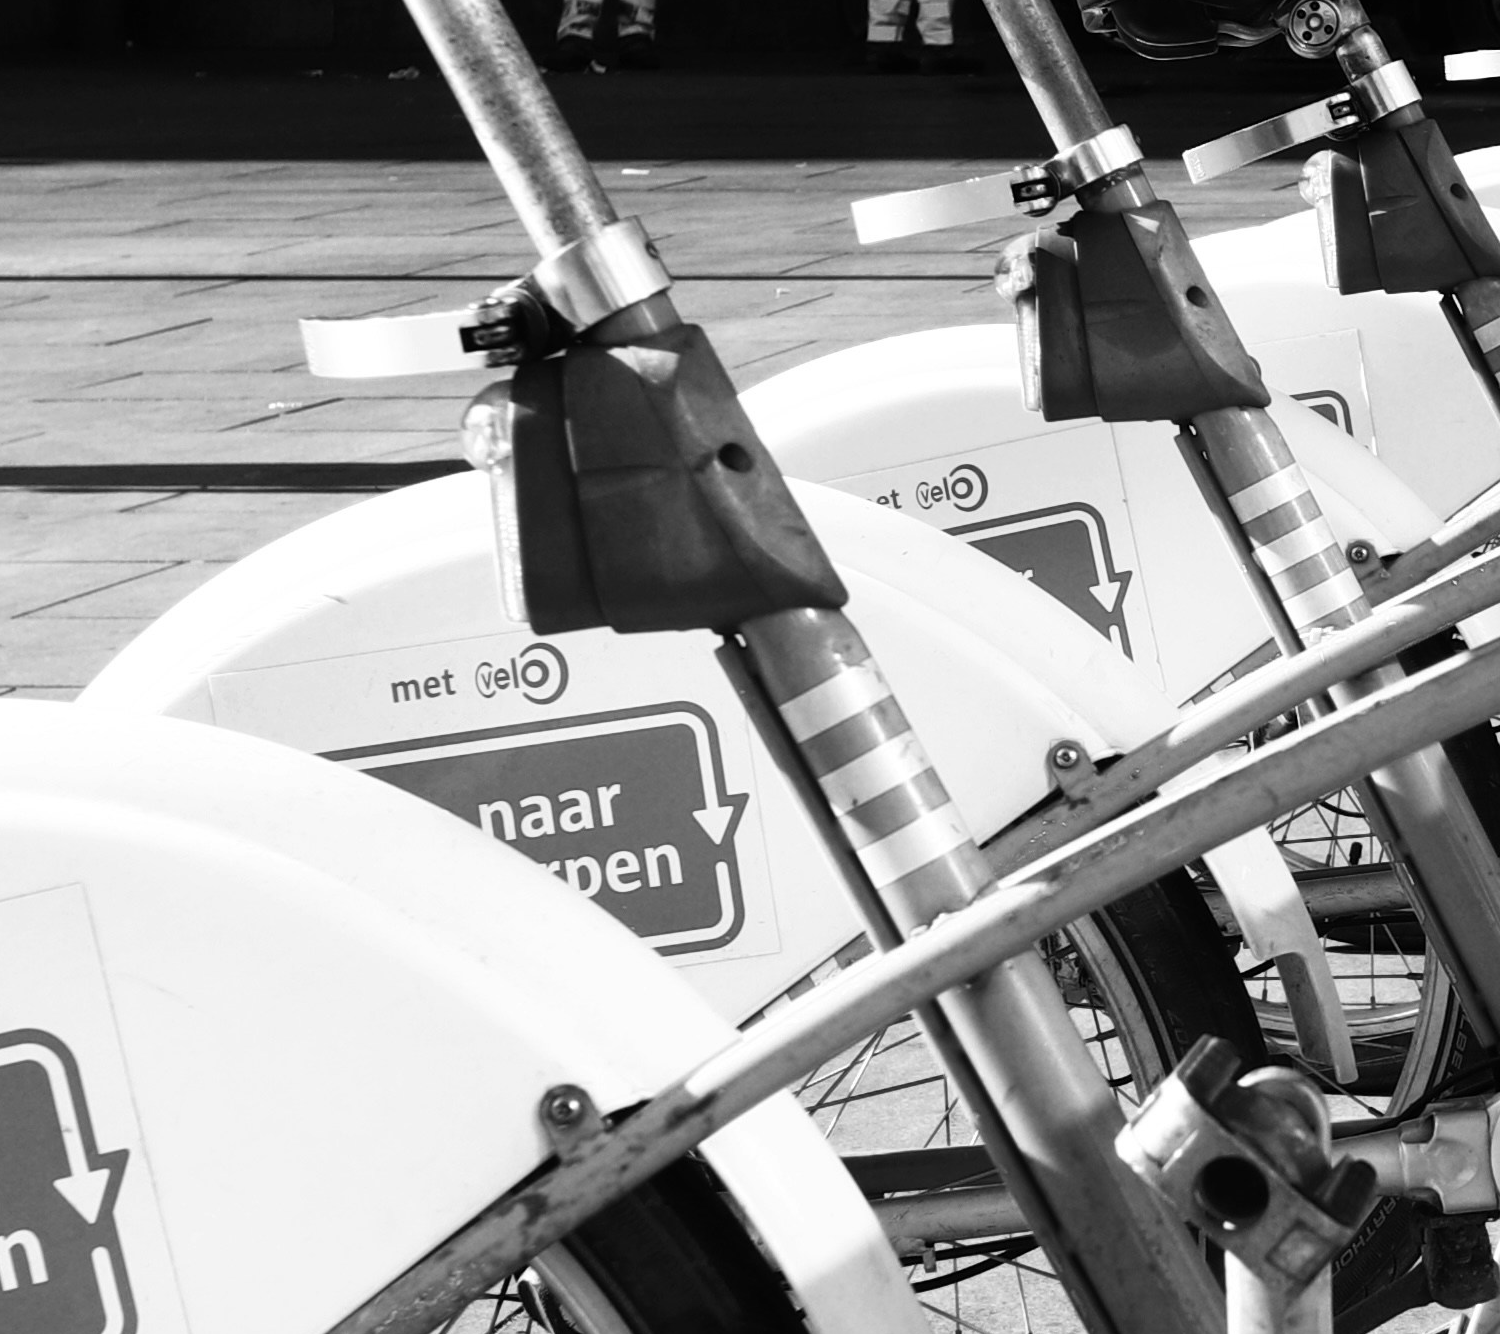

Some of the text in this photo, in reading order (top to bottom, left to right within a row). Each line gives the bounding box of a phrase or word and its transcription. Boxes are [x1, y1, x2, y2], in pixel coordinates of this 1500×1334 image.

[867, 489, 902, 509] et
[390, 670, 455, 703] met
[478, 783, 622, 842] naar
